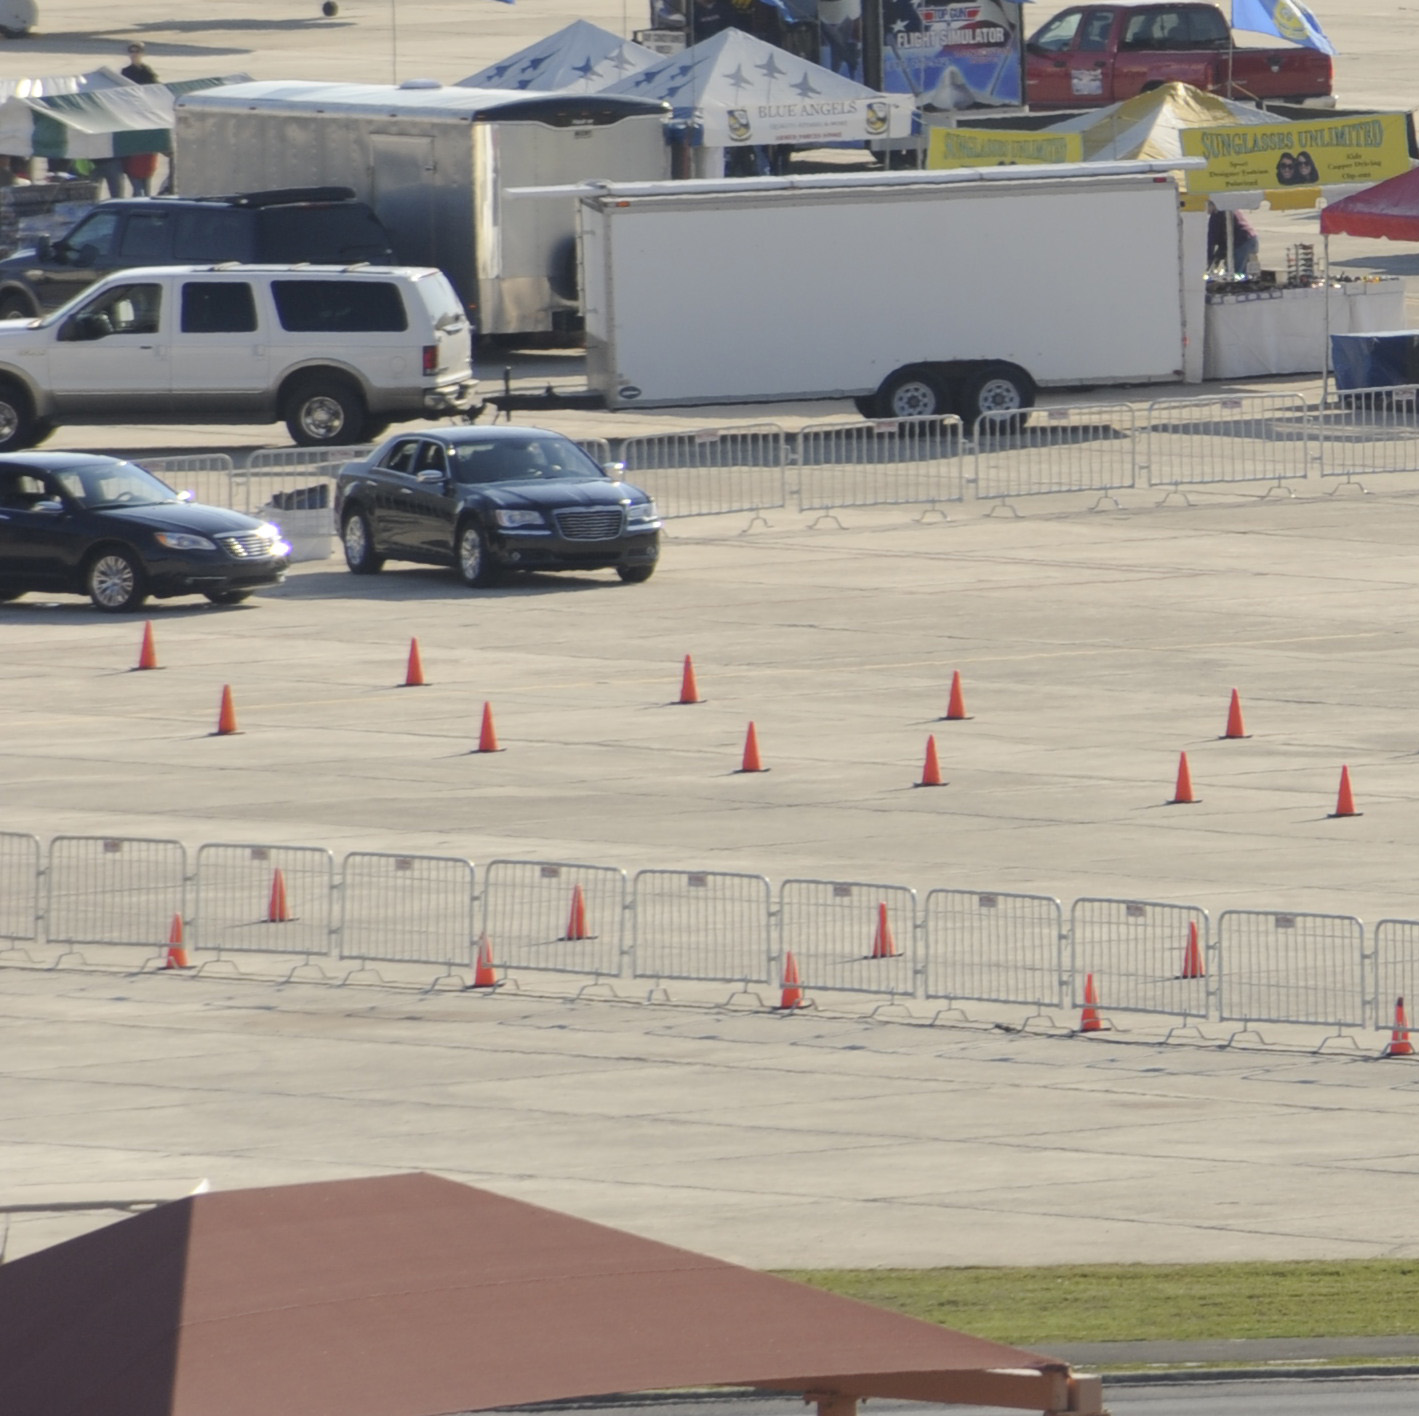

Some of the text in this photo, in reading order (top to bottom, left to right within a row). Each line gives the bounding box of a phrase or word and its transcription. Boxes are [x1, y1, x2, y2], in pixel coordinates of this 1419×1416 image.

[933, 7, 967, 19] TOP GUN
[897, 27, 1004, 48] FLIGHT SIMULATOR
[758, 101, 858, 119] BLUE ANGELS
[1201, 119, 1383, 159] SUNGLASSES UNLIMITED
